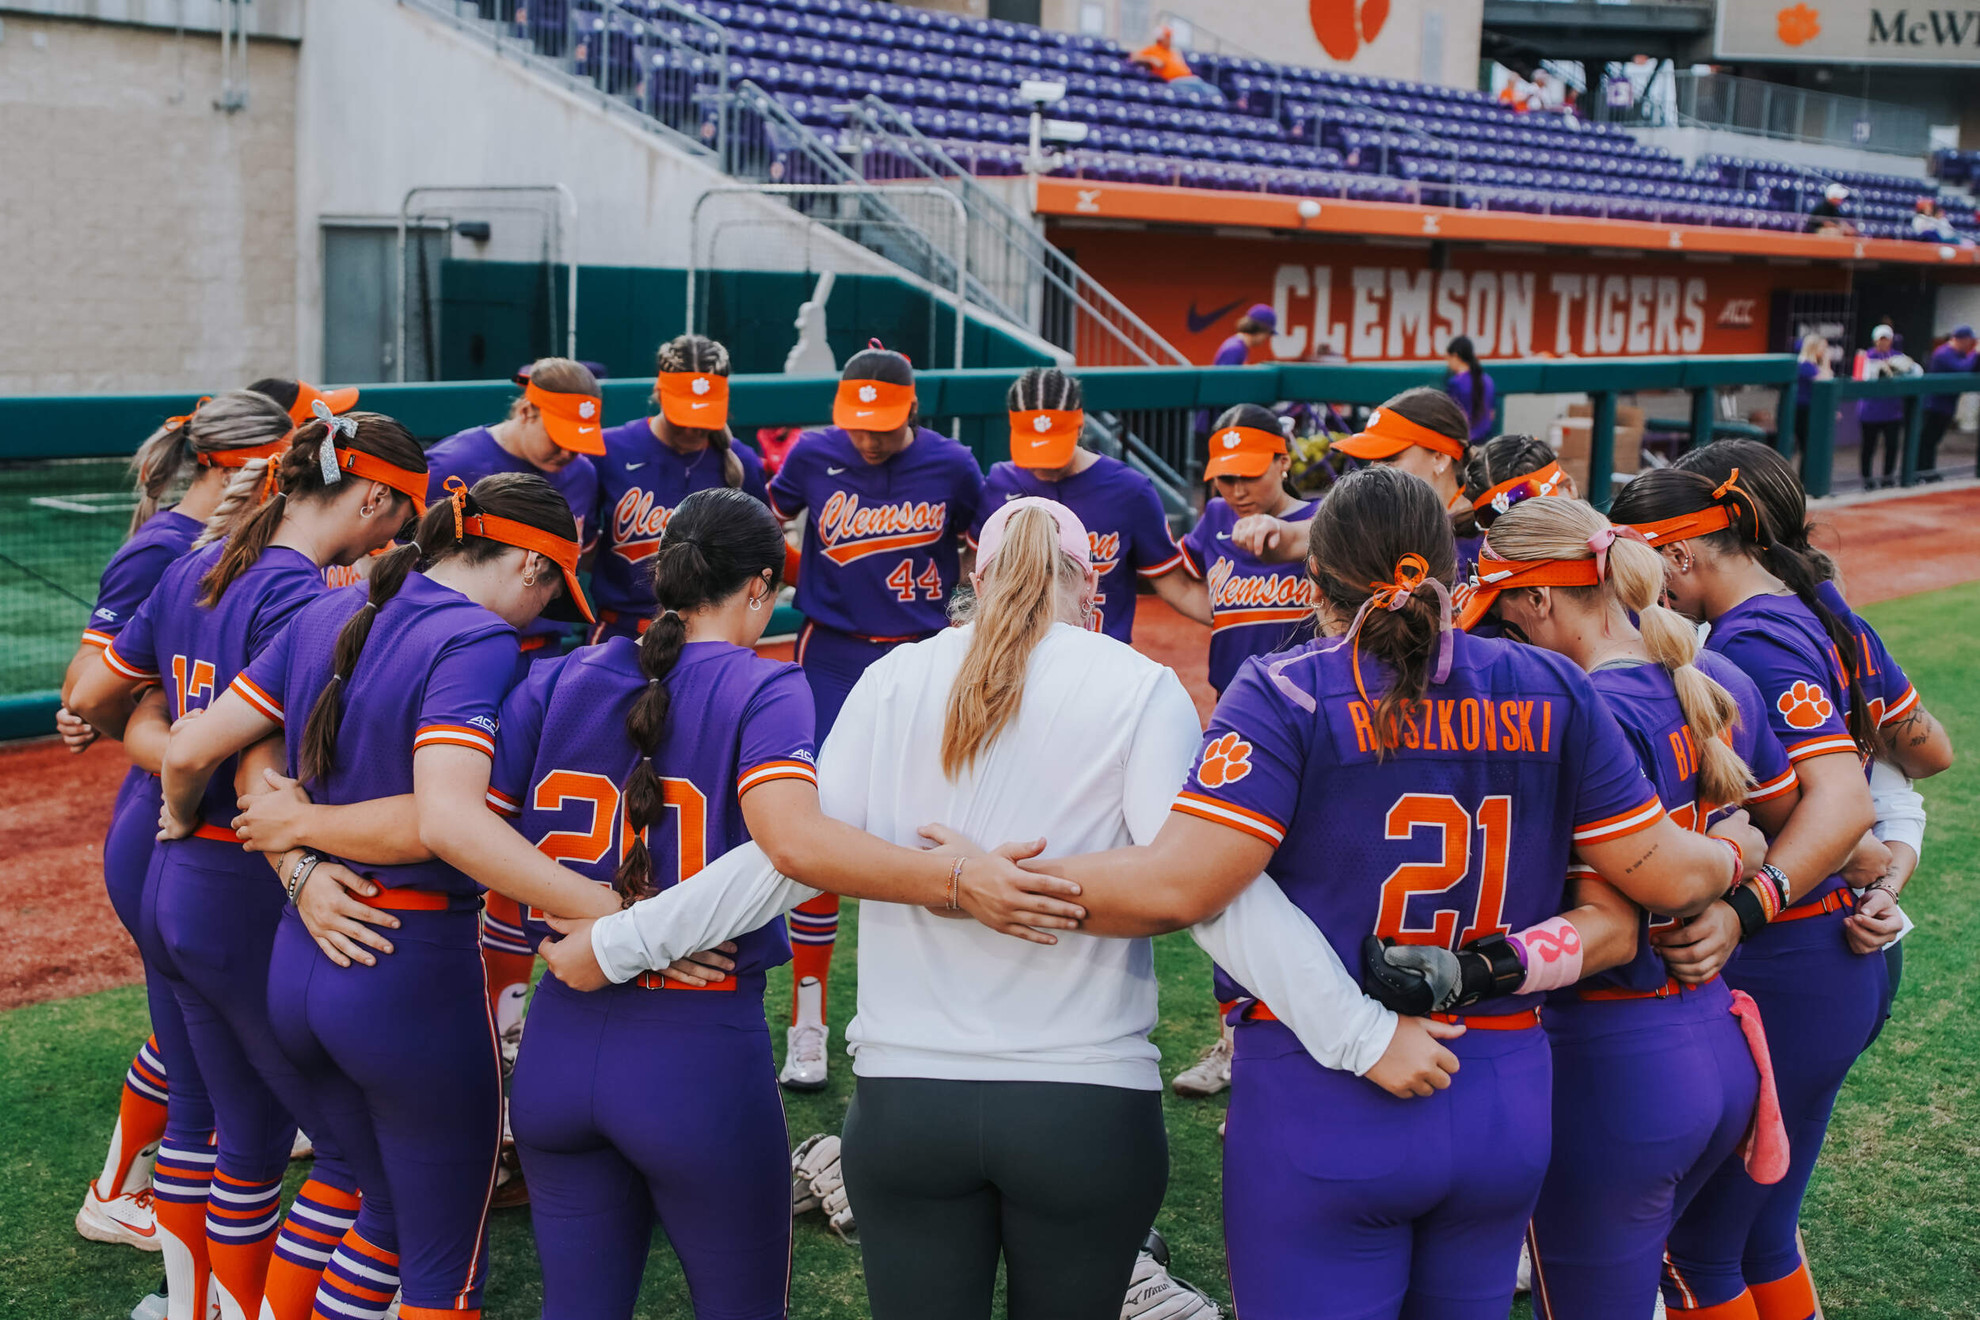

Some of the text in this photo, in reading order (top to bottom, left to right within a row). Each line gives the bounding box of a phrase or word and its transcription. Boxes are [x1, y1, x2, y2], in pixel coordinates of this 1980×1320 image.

[1271, 265, 1707, 359] CLEMSON TIGERS
[819, 491, 946, 547] Clemson
[886, 558, 943, 602] 44
[1374, 793, 1512, 951] 21
